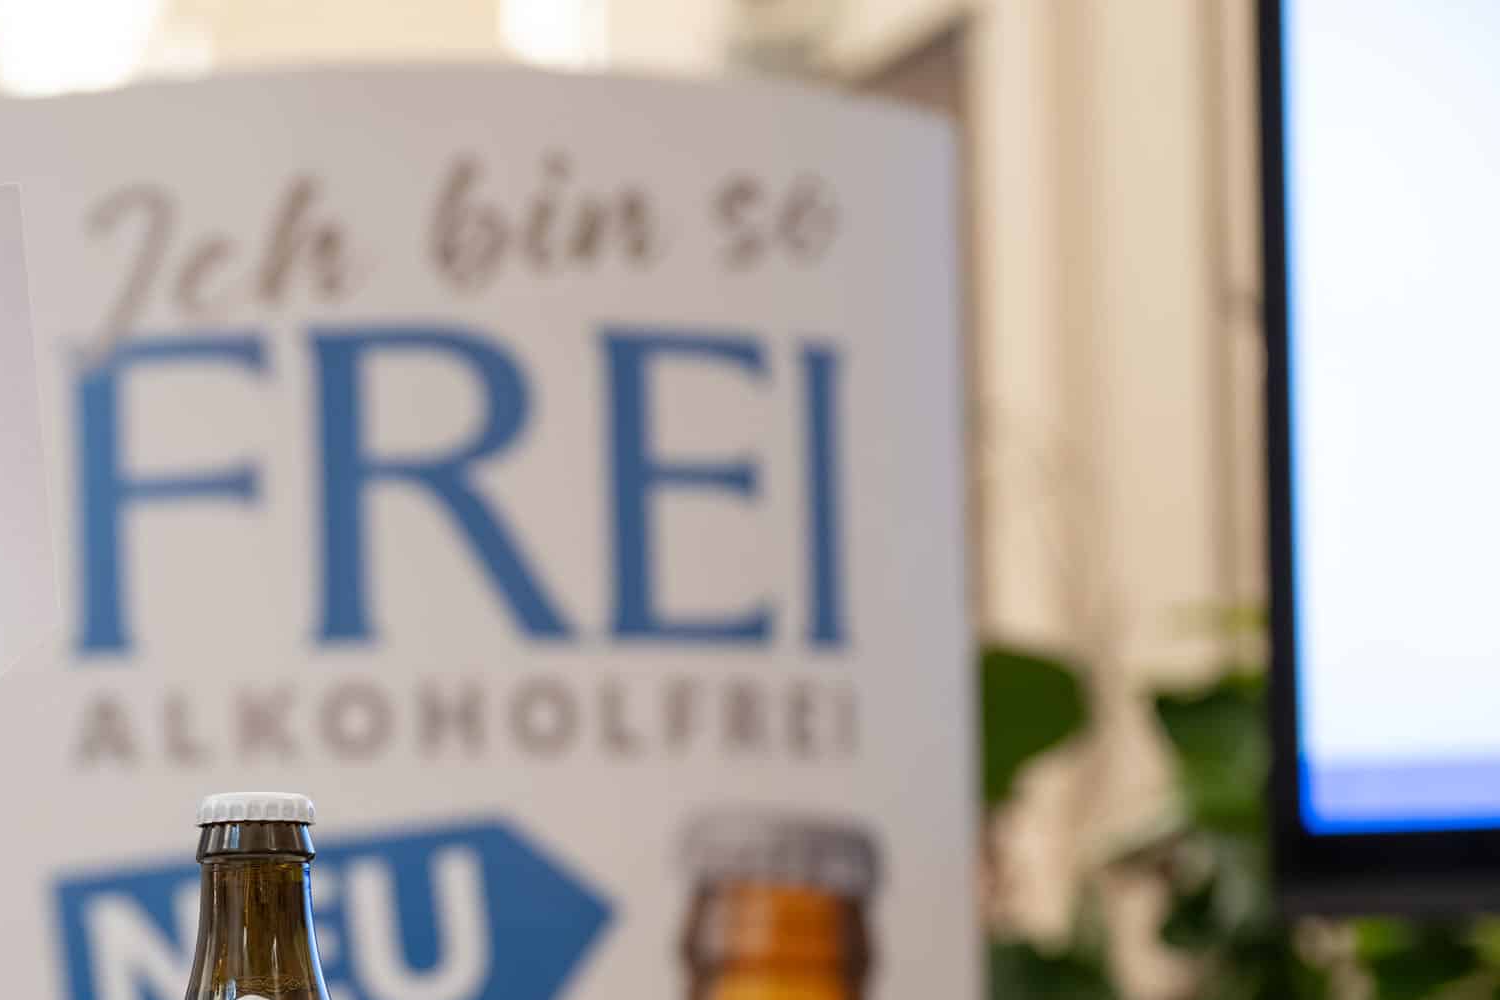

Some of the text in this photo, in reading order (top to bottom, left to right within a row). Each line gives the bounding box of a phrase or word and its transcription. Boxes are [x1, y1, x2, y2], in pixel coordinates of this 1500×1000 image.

[70, 149, 841, 362] Ich bin so
[67, 319, 852, 664] FREI
[73, 676, 860, 770] ALKOHOLFREI
